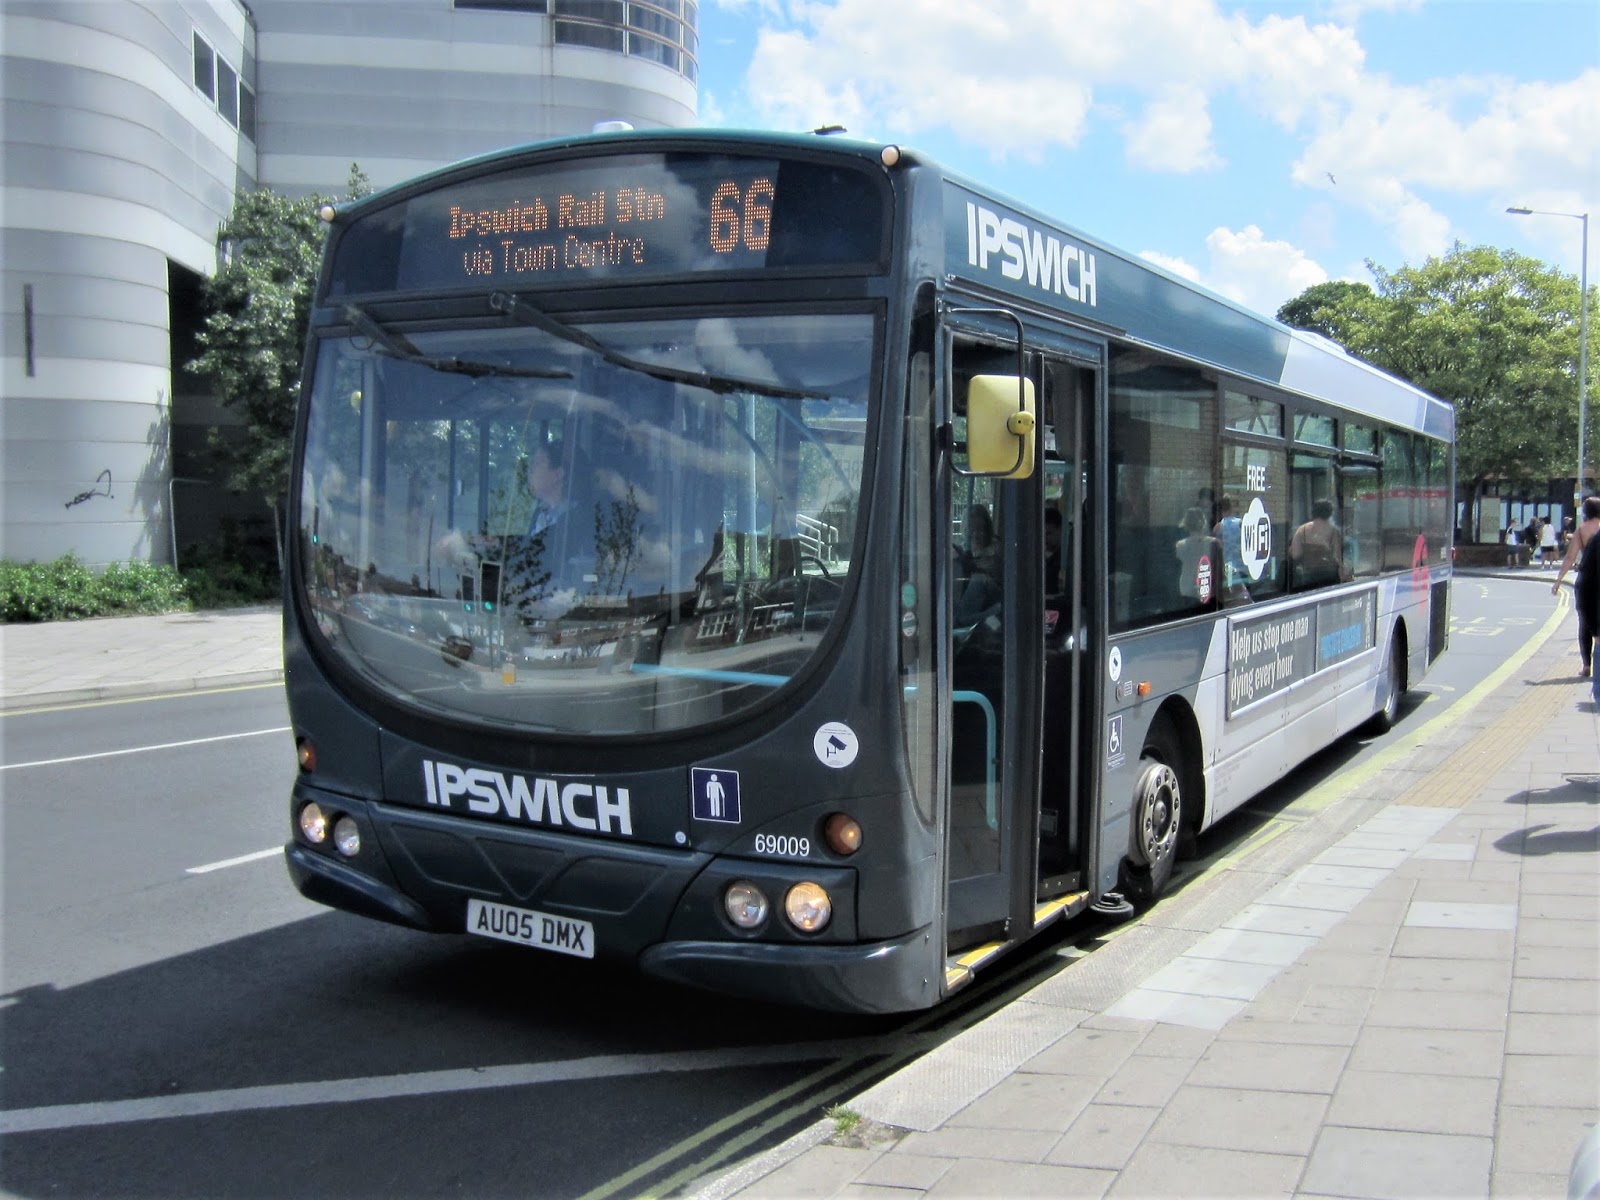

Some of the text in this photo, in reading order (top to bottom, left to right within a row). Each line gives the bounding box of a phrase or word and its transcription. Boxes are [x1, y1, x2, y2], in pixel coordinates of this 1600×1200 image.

[449, 187, 665, 238] Ipswich Rail Stn
[709, 178, 775, 253] 66
[463, 231, 646, 275] via Town Centre
[966, 200, 1097, 307] IPSWICH
[1246, 464, 1266, 492] FREE
[1231, 627, 1251, 664] Help
[1252, 630, 1263, 655] us
[1263, 623, 1280, 653] stop
[1280, 620, 1294, 645] one
[1294, 616, 1309, 640] man
[1230, 652, 1294, 706] dying every hour
[423, 760, 633, 836] IPSWICH
[754, 833, 811, 857] 69009
[477, 905, 585, 951] AU05 DMX
